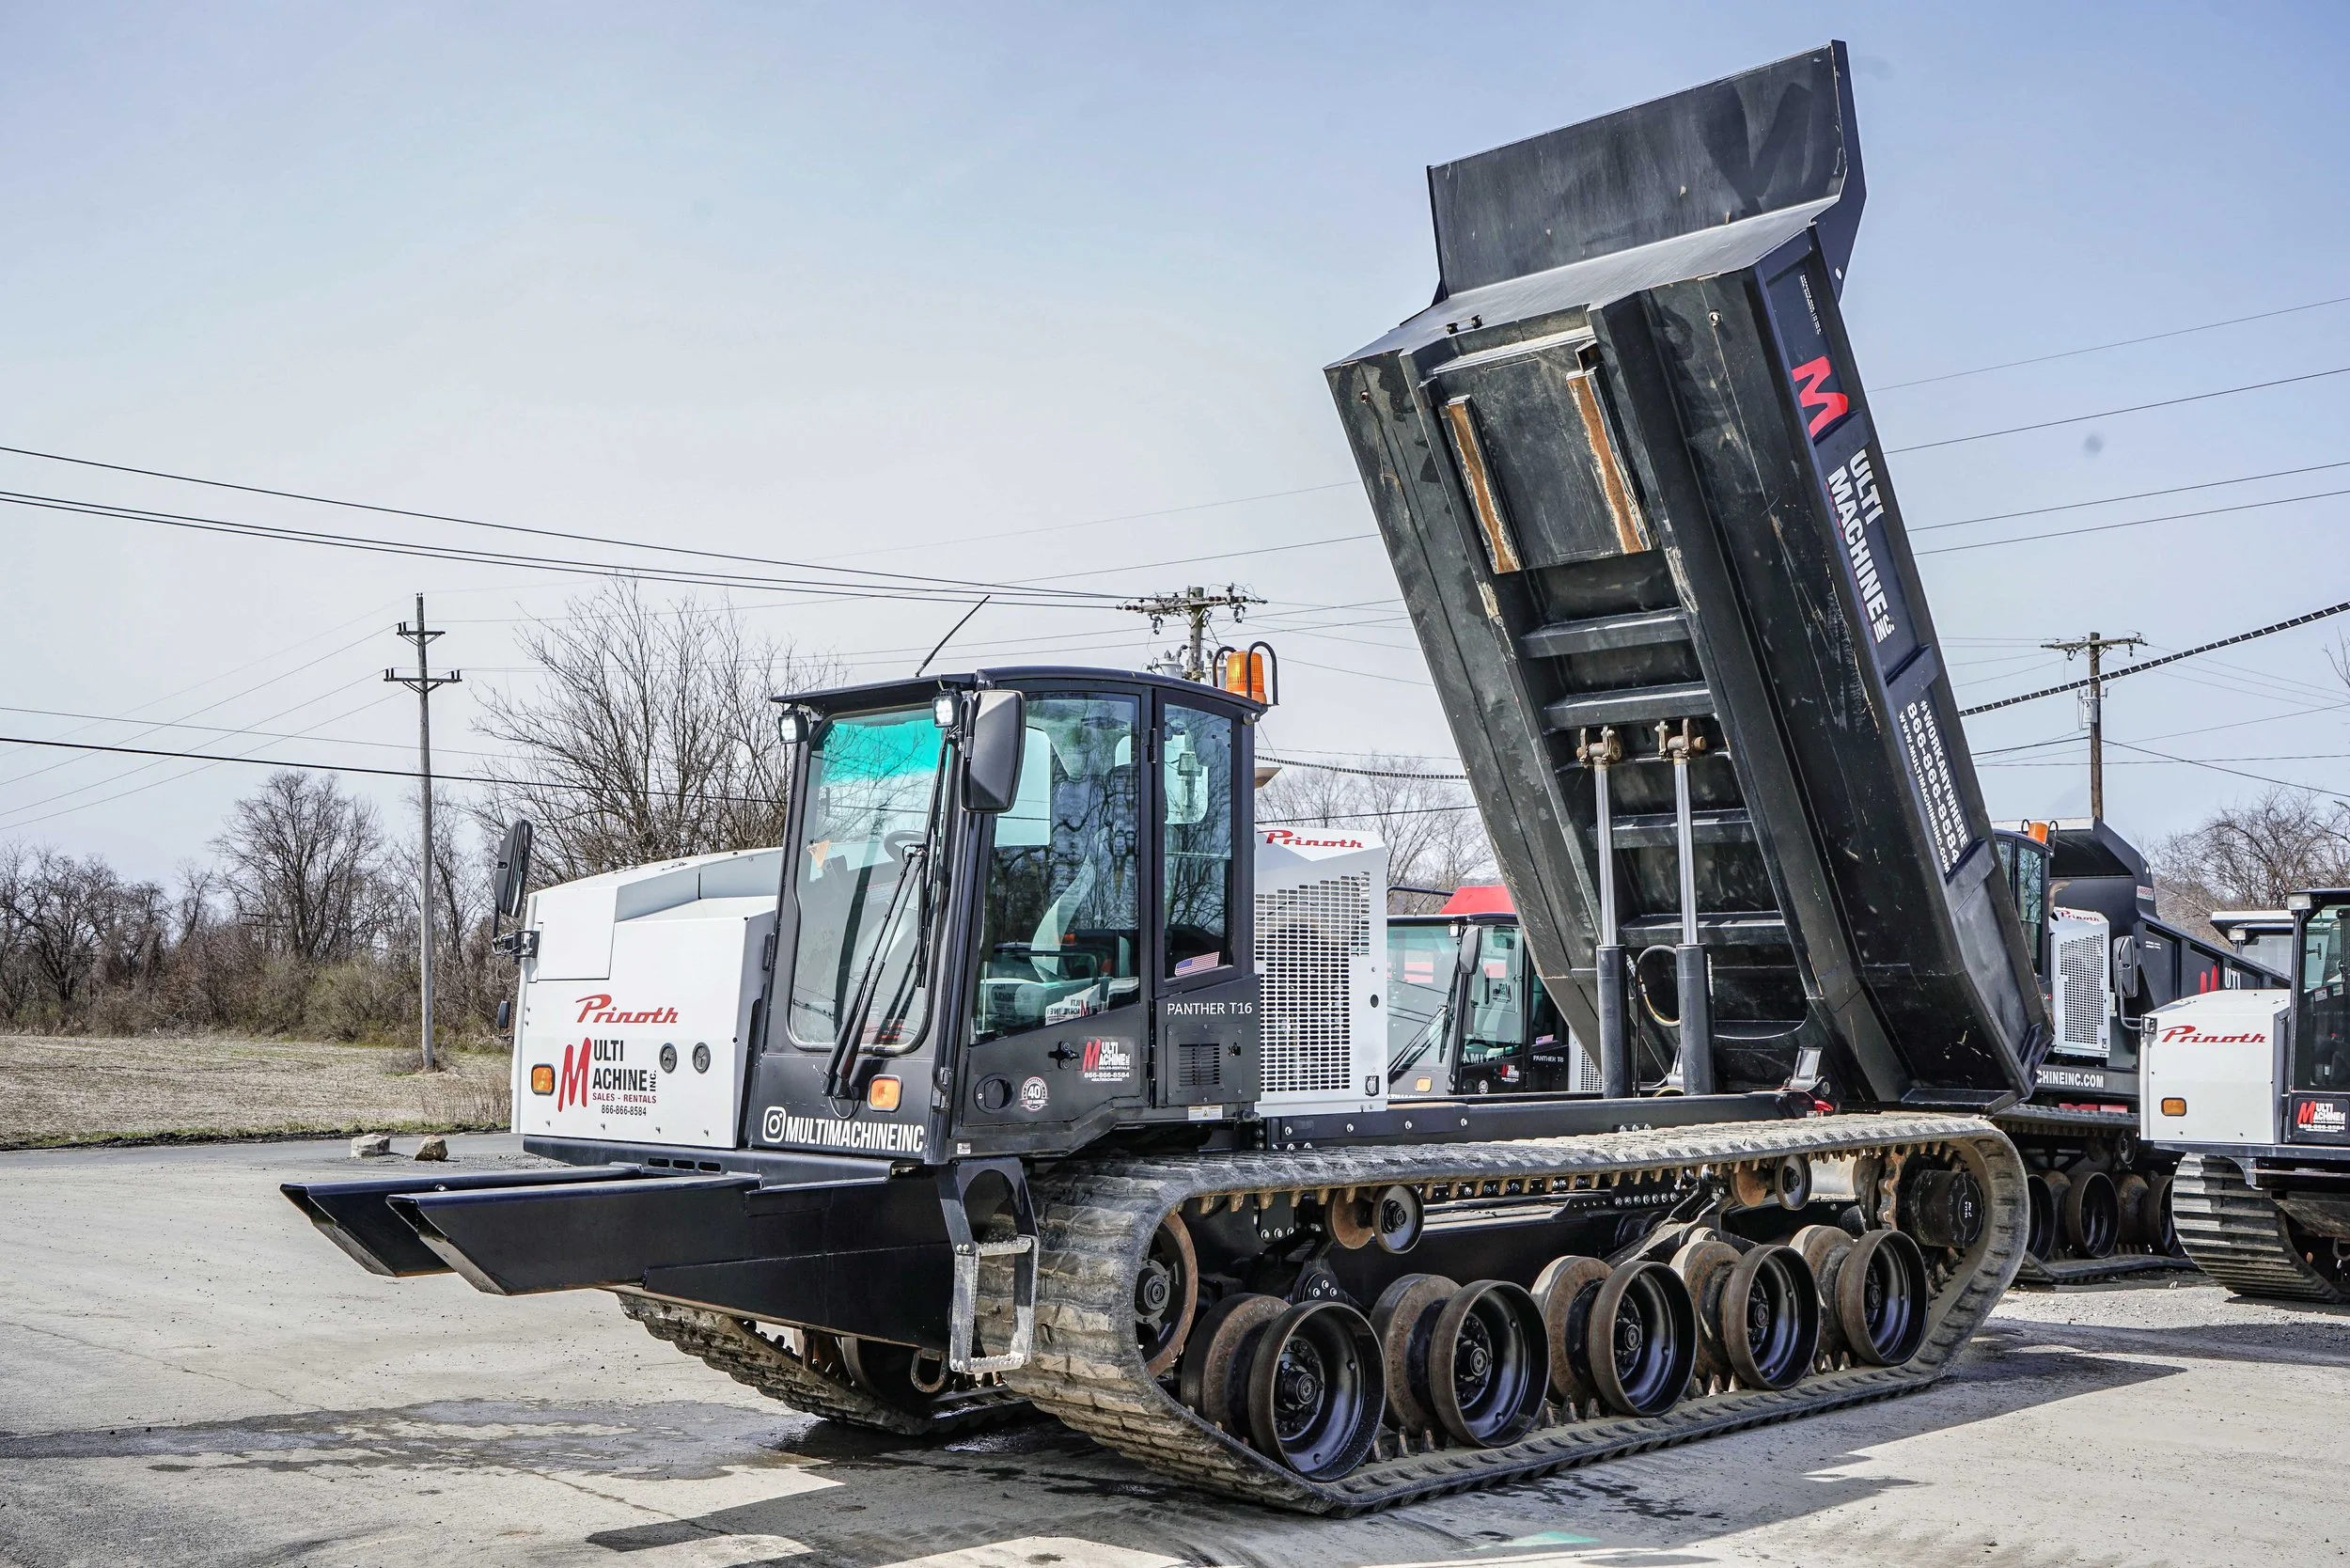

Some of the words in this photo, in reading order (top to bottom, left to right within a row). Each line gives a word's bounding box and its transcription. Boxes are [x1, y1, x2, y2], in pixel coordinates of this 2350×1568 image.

[1827, 464, 1887, 621] MACHINE
[1873, 613, 1895, 644] INC.
[1906, 701, 1961, 865] 866-866-8584
[1919, 699, 1968, 848] #WORKANYWHERE
[1898, 712, 1950, 874] WWW.MULTIMACHINEINC.COM
[1257, 829, 1364, 848] Prinoth
[575, 994, 679, 1024] Prinoth
[1167, 1002, 1226, 1015] PANTHER
[1229, 1002, 1253, 1014] T16
[2158, 1025, 2266, 1043] Prinoth
[649, 1070, 657, 1091] INC.
[592, 1091, 616, 1102] SALES
[623, 1093, 657, 1104] RENTALS
[1027, 1085, 1042, 1099] 40
[601, 1104, 647, 1116] 866-866-8584
[785, 1116, 925, 1152] MULTIMACHINEINC
